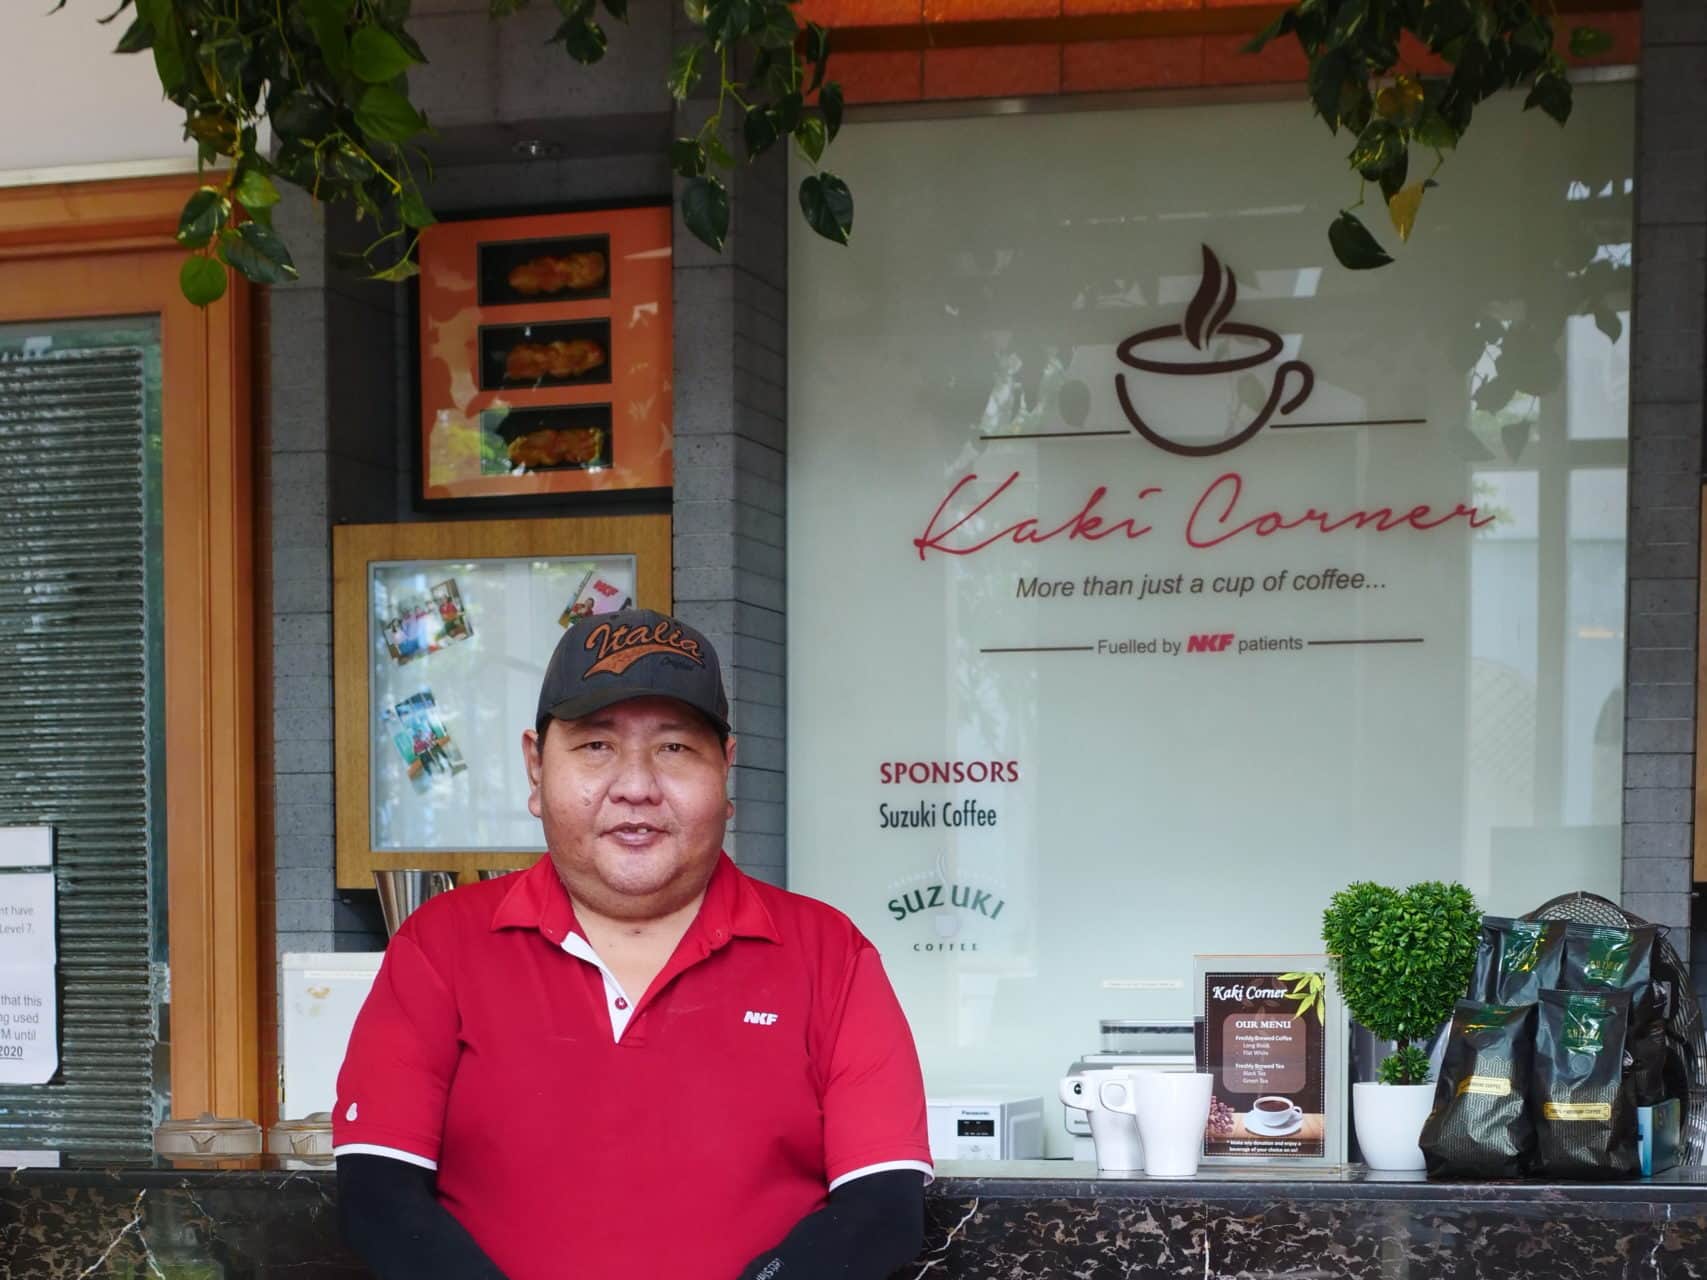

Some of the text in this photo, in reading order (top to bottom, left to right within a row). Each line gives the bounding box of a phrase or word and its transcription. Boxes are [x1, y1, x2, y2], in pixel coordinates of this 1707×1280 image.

[913, 471, 1497, 561] Kaki Corner
[1016, 568, 1386, 600] More than just a cup of coffee...
[584, 620, 704, 661] Italia
[1097, 633, 1304, 656] Fuelled by NKF patients
[879, 760, 1019, 784] SPONSORS
[879, 799, 998, 829] Suzuki Coffee
[11, 904, 35, 916] have
[887, 884, 1006, 922] SUZUKI
[913, 942, 979, 952] COFFEE
[0, 993, 42, 1007] that this
[1212, 984, 1288, 1001] Kaki Corner
[12, 1012, 39, 1024] used
[743, 1010, 779, 1026] NKF
[1235, 1020, 1292, 1029] OUR MENU
[14, 1027, 37, 1041] until
